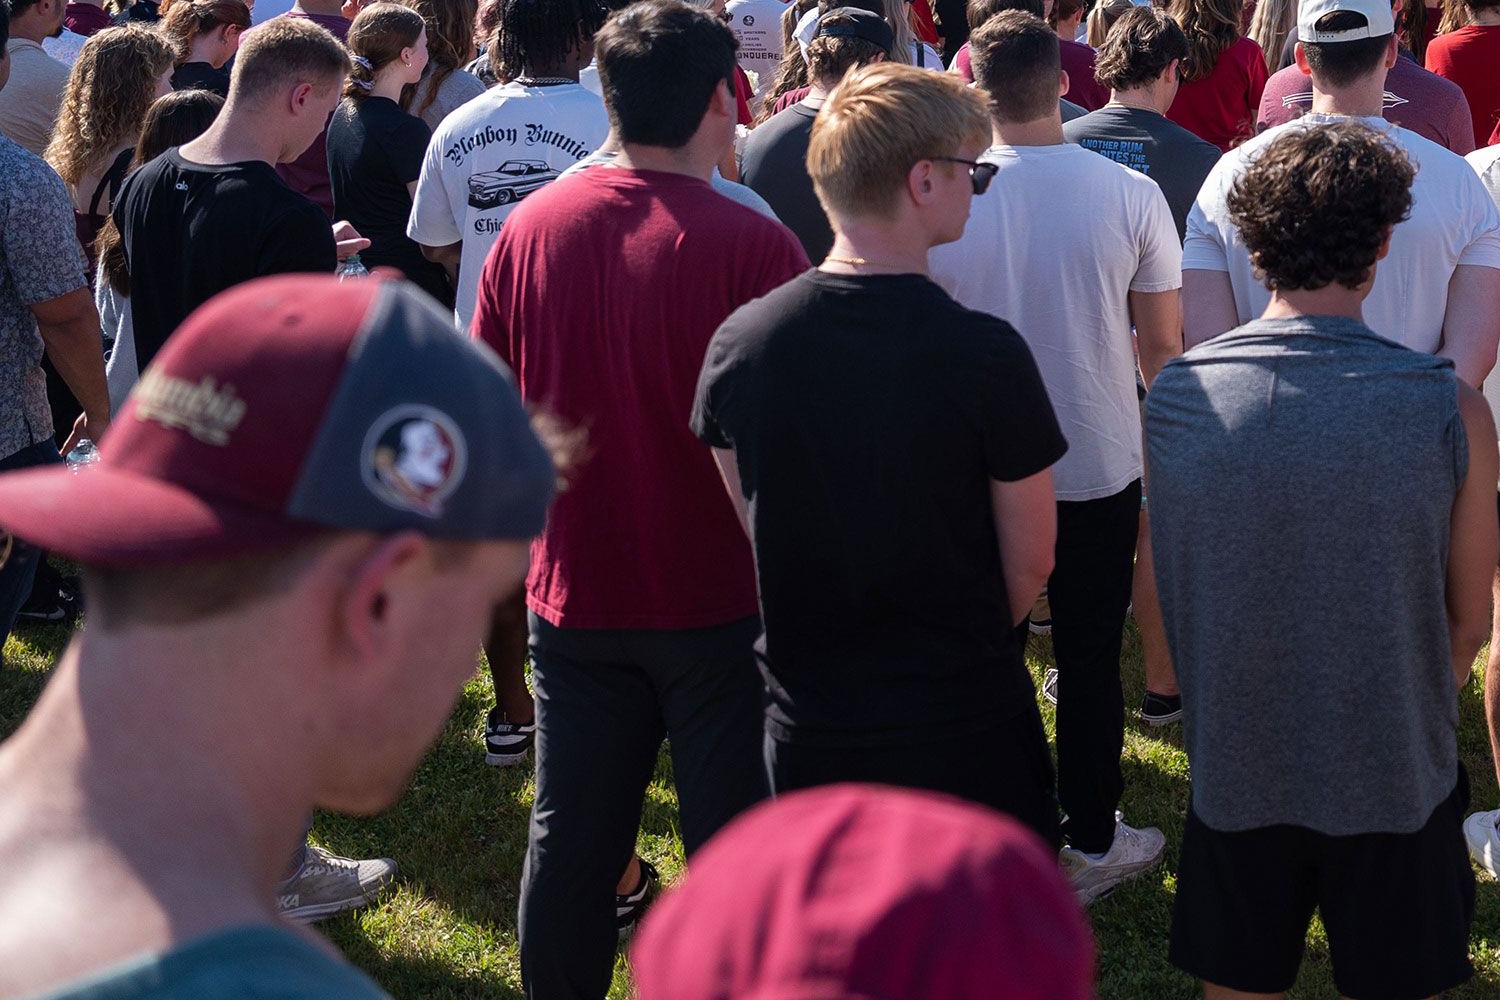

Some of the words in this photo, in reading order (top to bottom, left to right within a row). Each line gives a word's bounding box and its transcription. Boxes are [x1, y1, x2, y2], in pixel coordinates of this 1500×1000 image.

[444, 124, 518, 168] Playboy
[1081, 139, 1119, 149] ANOTHER
[1120, 142, 1144, 153] RUM
[1130, 154, 1146, 163] THE
